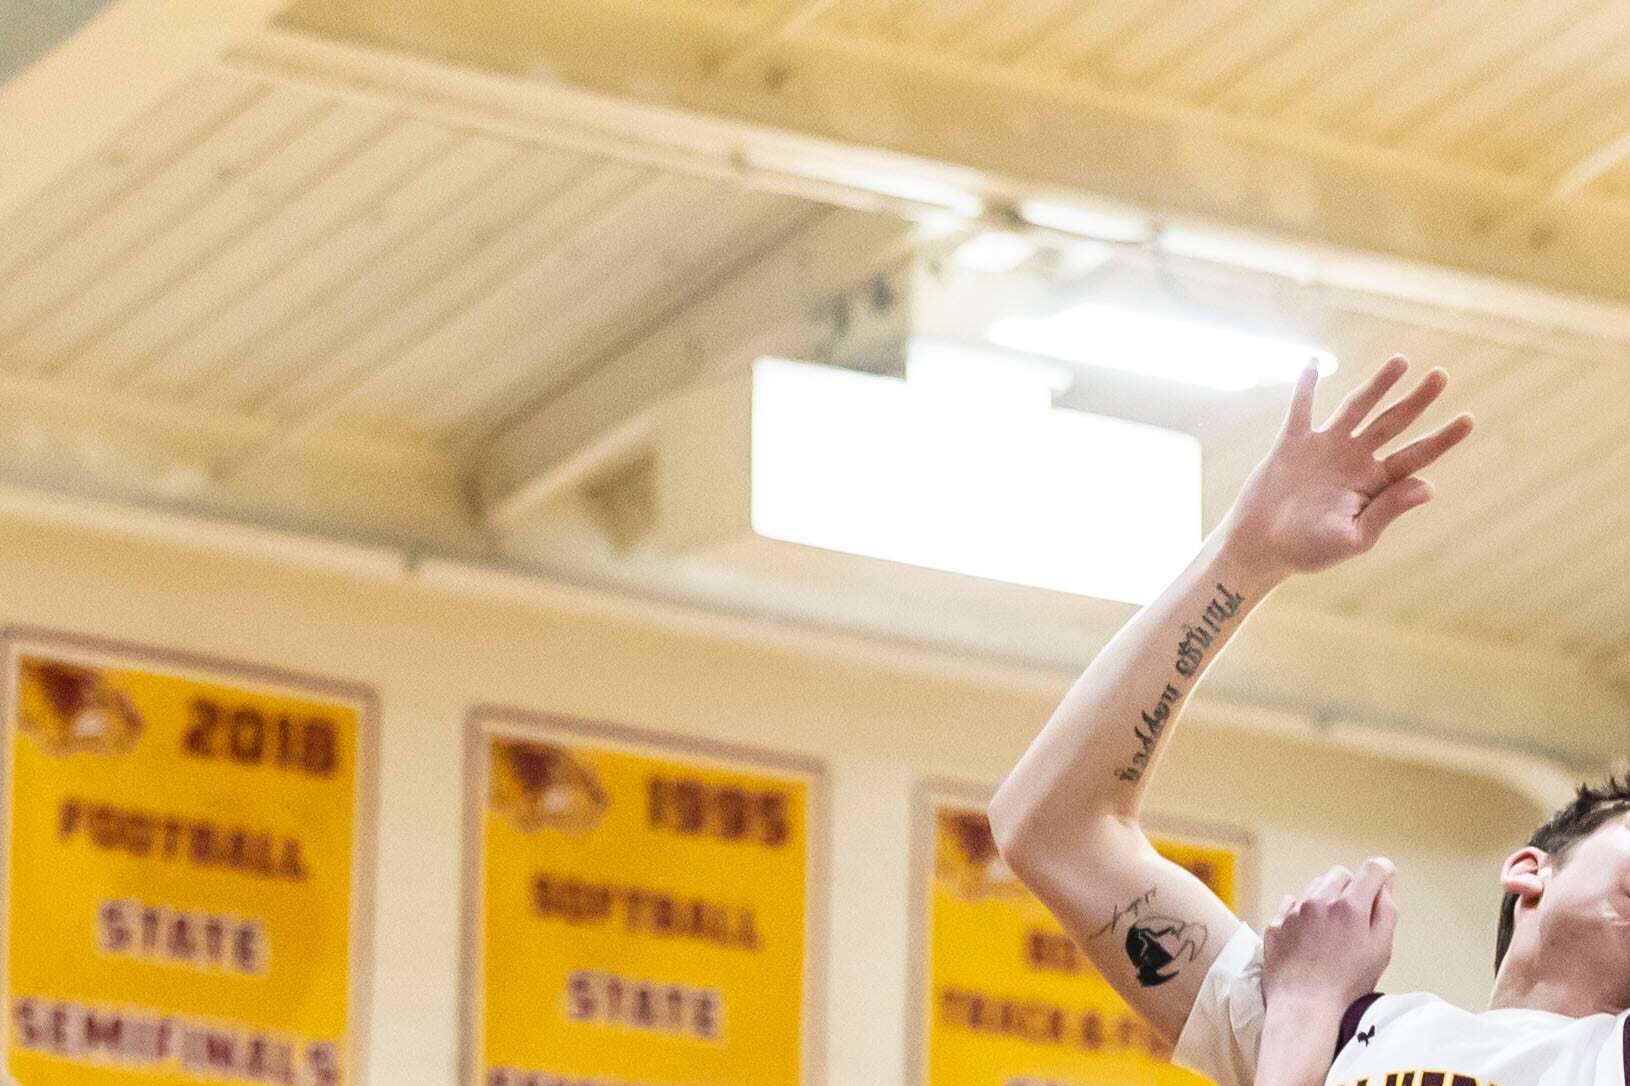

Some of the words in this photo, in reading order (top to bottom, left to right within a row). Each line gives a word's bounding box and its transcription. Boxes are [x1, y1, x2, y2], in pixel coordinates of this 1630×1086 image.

[182, 694, 339, 777] 2018
[56, 796, 310, 884] FOOTBALL
[97, 899, 267, 977] STATE
[529, 869, 765, 953] SOFTBALL
[567, 969, 724, 1044] STATE
